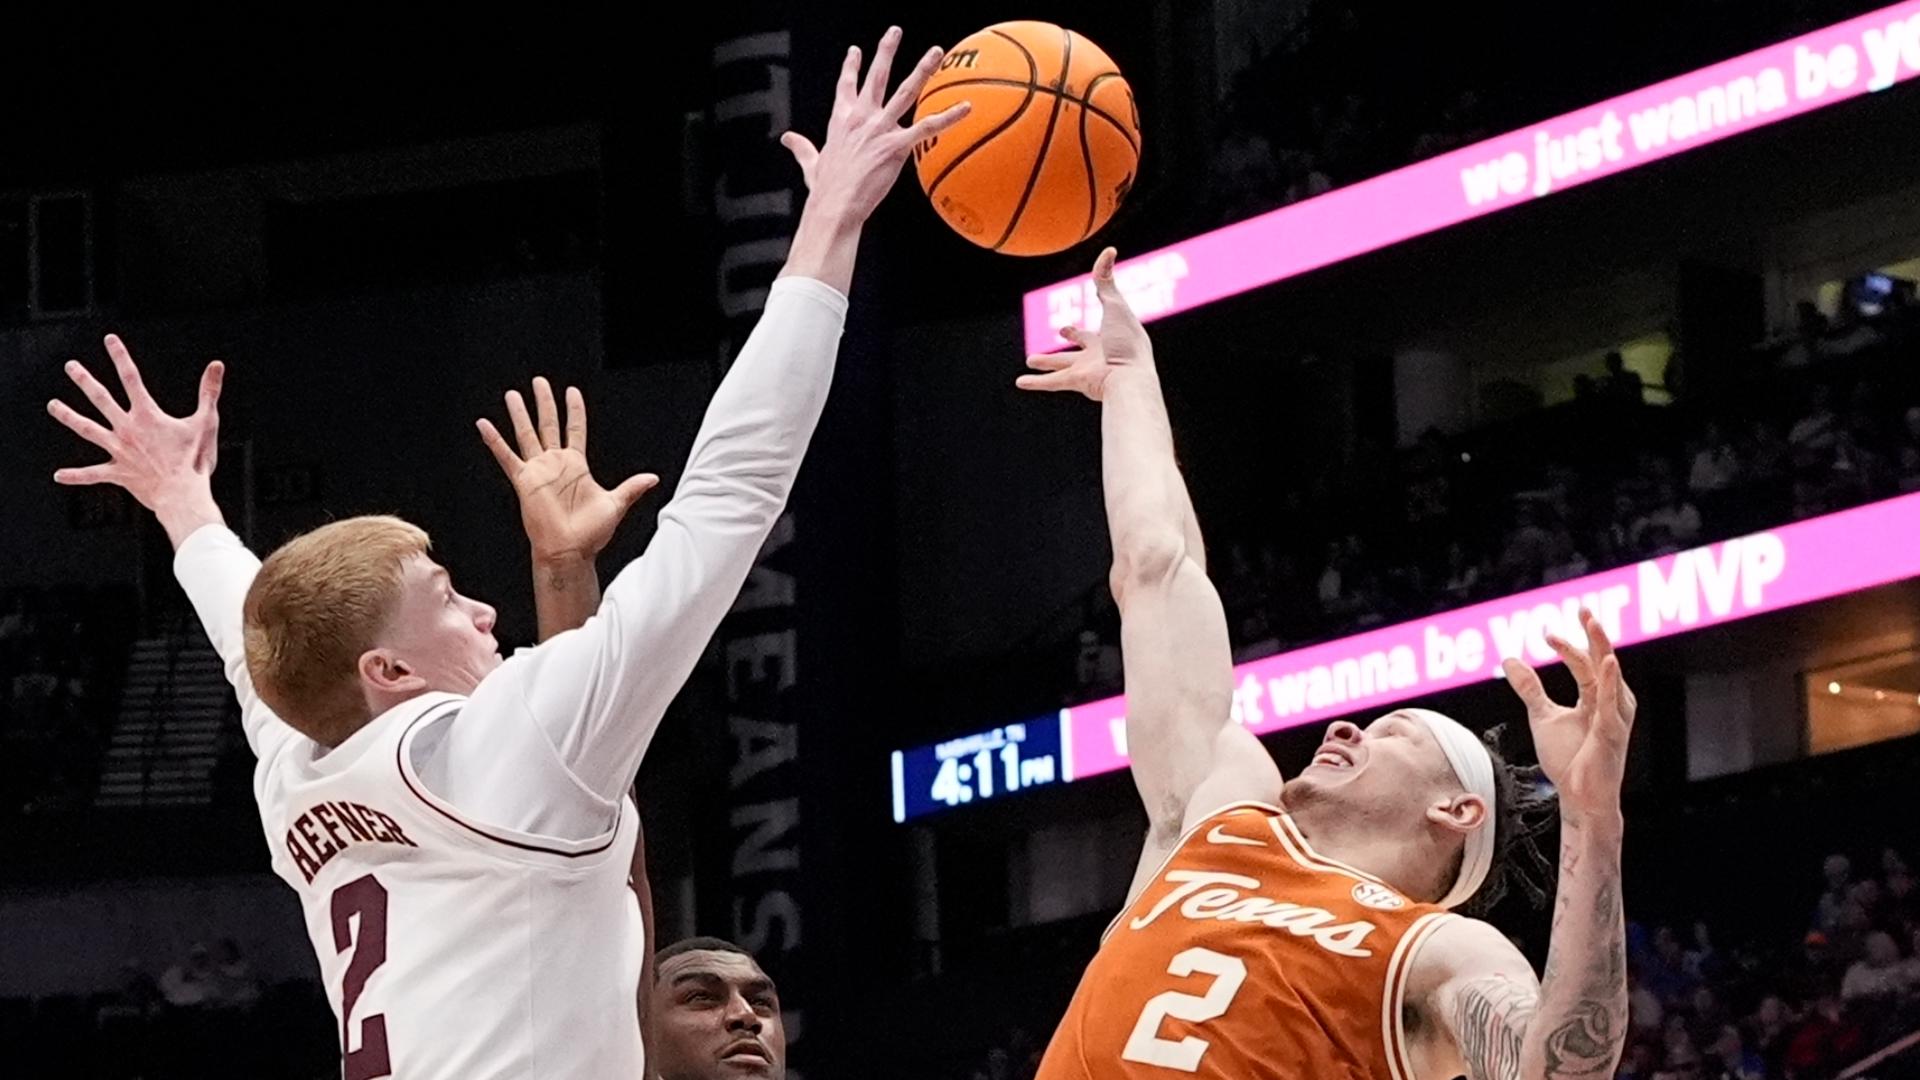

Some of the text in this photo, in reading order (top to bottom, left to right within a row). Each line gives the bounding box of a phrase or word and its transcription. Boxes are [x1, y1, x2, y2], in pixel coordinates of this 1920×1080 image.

[1460, 150, 1528, 206] we
[1532, 130, 1624, 197] just
[1628, 67, 1787, 152] wanna
[1794, 44, 1858, 100] be
[1268, 646, 1418, 711] wanna
[1424, 625, 1485, 681] be
[1637, 531, 1786, 634] MVP
[331, 873, 392, 1080] 2
[1129, 868, 1376, 958] Texas
[1121, 946, 1248, 1073] 2
